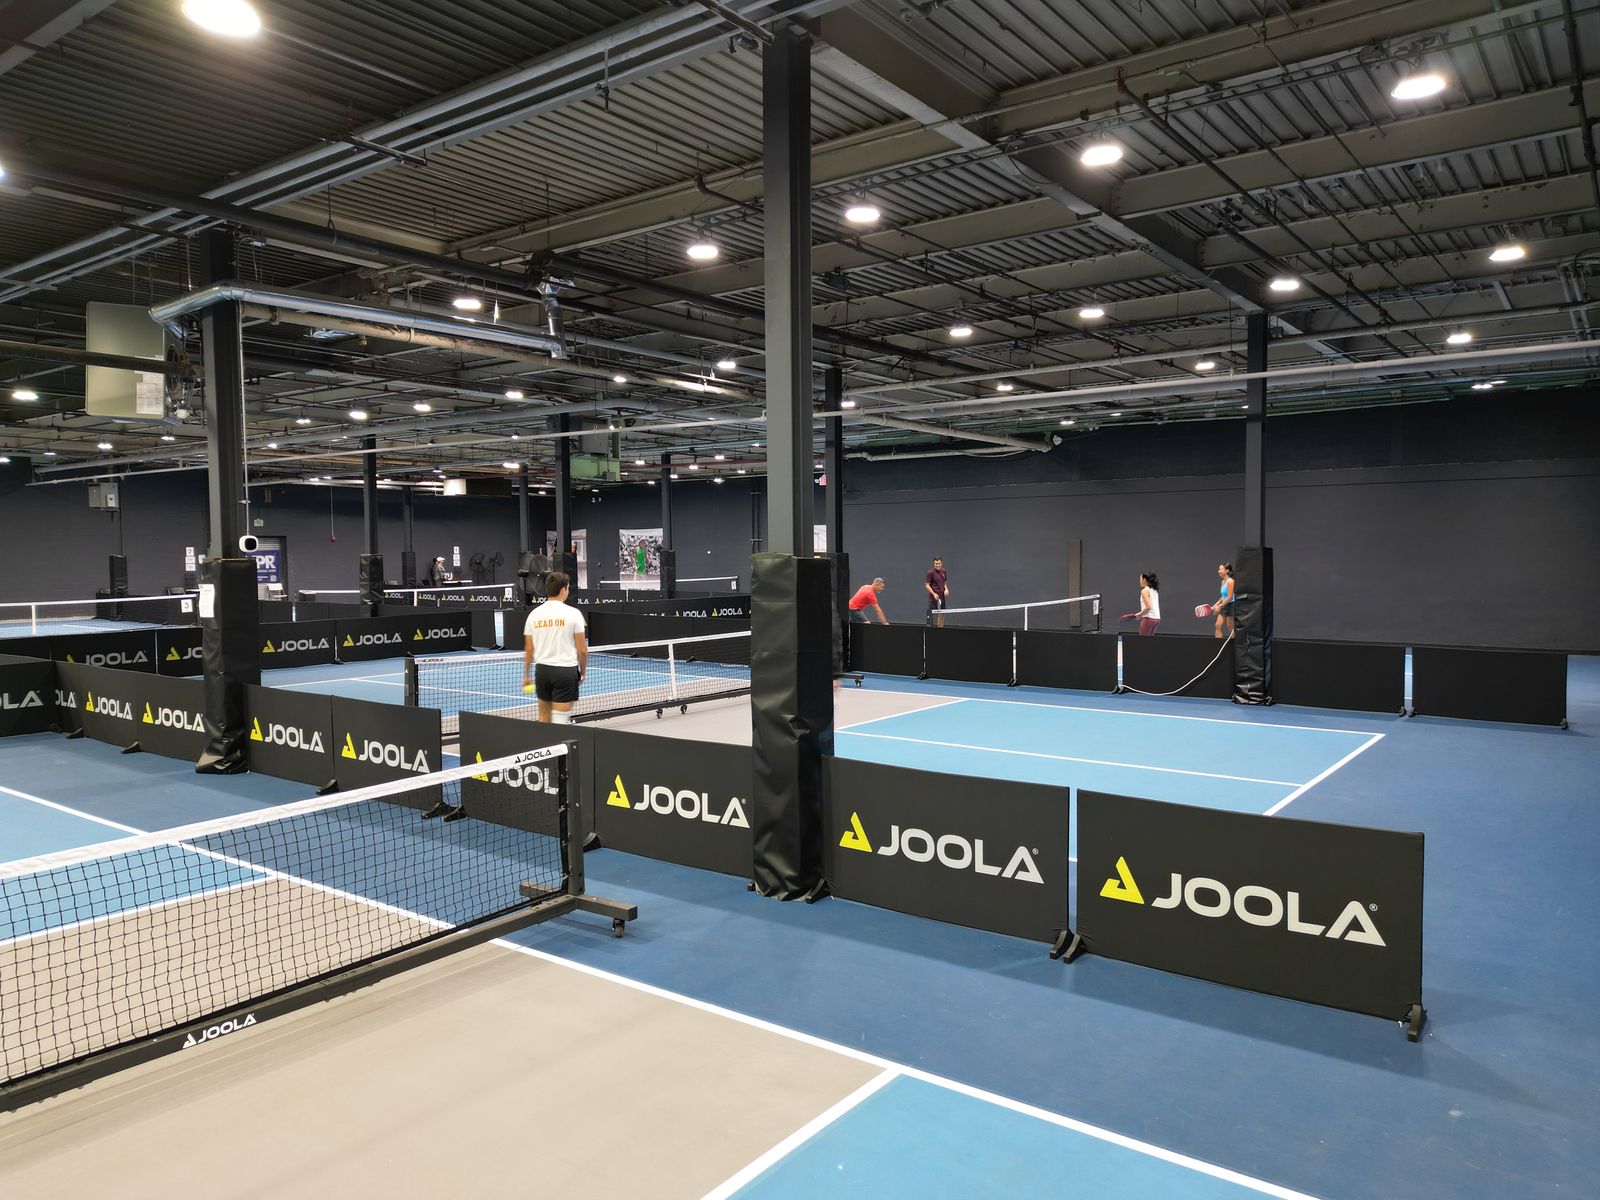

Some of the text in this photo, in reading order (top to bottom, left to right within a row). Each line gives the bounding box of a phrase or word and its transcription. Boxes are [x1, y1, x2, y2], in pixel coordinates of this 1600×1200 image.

[718, 607, 743, 616] JOOLA
[424, 627, 467, 640] JOOLA
[533, 619, 565, 628] LEAD ON
[277, 638, 330, 652] JOOLA
[355, 632, 403, 646] JOOLA
[0, 690, 44, 710] LA
[95, 696, 133, 720] JOOLA
[155, 707, 206, 732] JOOLA
[264, 723, 325, 753] JOOLA
[358, 740, 431, 773] JOOLA
[523, 749, 552, 762] JOOLA
[633, 784, 751, 828] JOOLA
[197, 1013, 257, 1044] JOOLA
